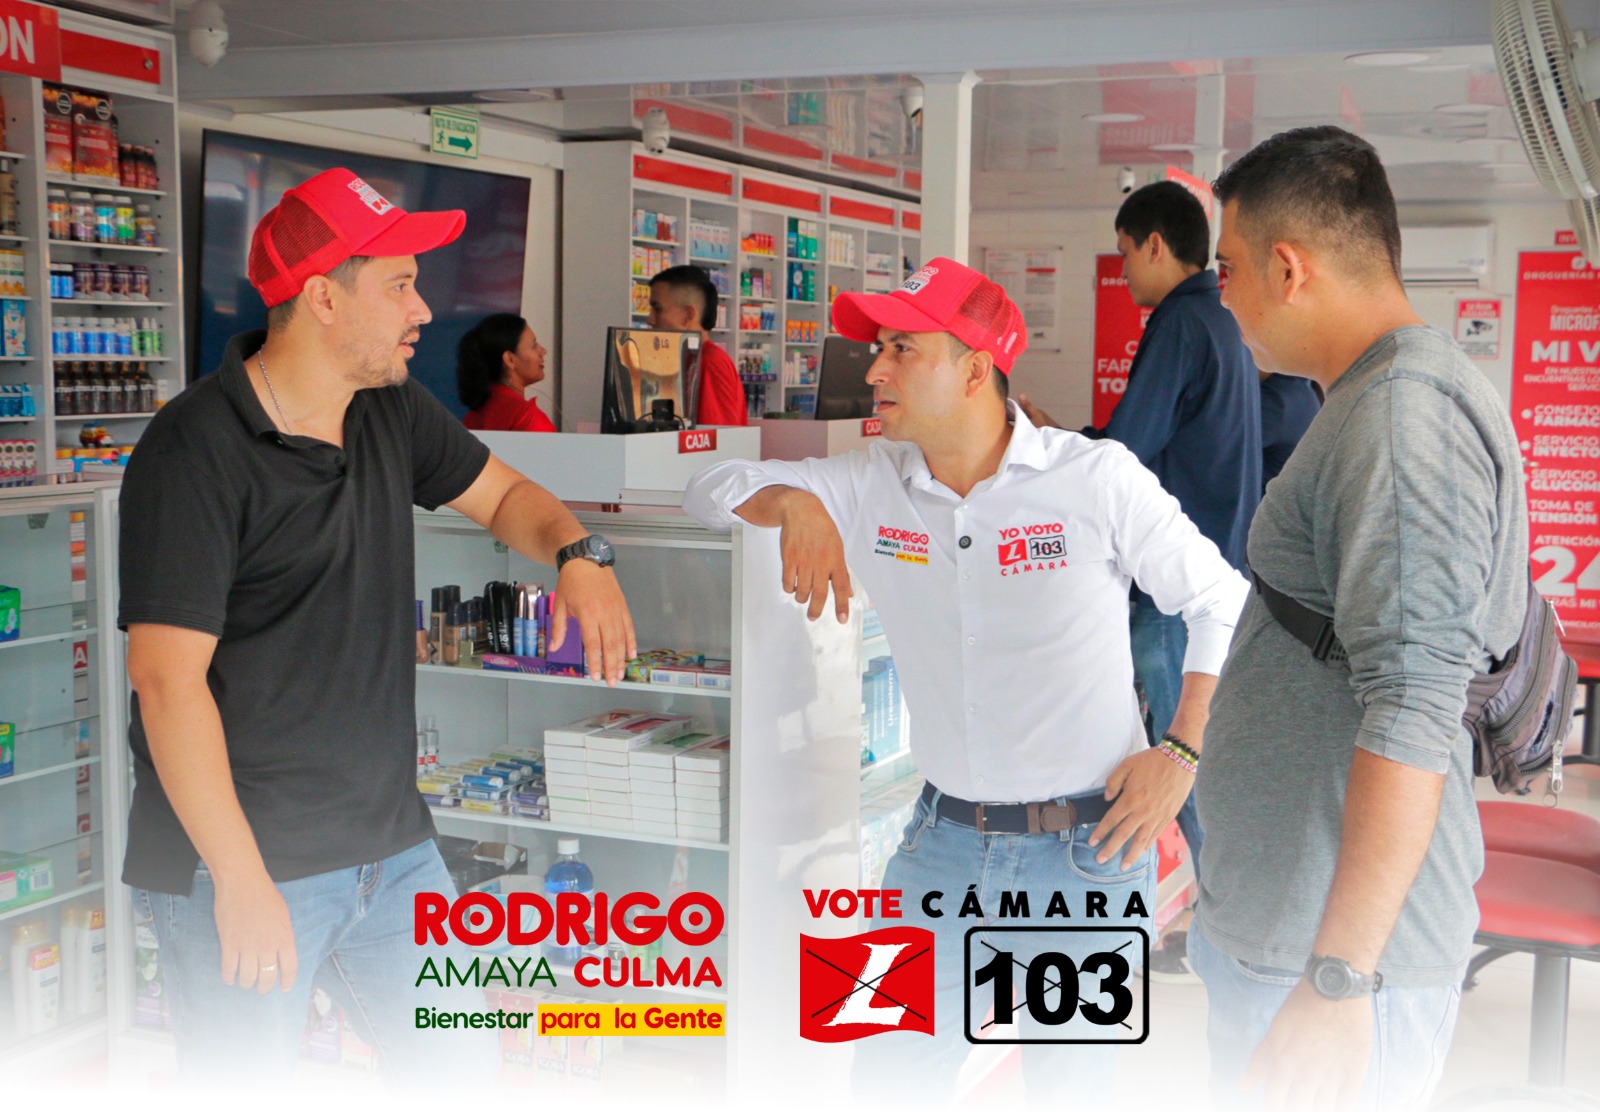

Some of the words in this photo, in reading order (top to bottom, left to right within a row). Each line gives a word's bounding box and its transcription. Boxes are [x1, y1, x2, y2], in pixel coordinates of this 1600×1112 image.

[1549, 314, 1600, 331] MICROF
[1531, 340, 1570, 363] MI
[1578, 340, 1600, 363] V
[1534, 404, 1600, 416] CONSEJO
[1533, 415, 1600, 428] FARMAC
[685, 433, 710, 450] CAJA
[1533, 434, 1599, 447] SERVICIO
[1532, 446, 1600, 458] INYECTO
[1531, 467, 1597, 480] SERVICIO
[1529, 499, 1571, 511] TOMA
[1573, 501, 1594, 512] DE
[878, 525, 929, 545] RODRIGO
[998, 527, 1020, 541] YO
[1022, 523, 1064, 536] VOTO
[876, 538, 901, 549] AMAYA
[902, 544, 929, 554] CULMA
[1031, 540, 1063, 556] 103
[1000, 559, 1068, 577] CÁMARA
